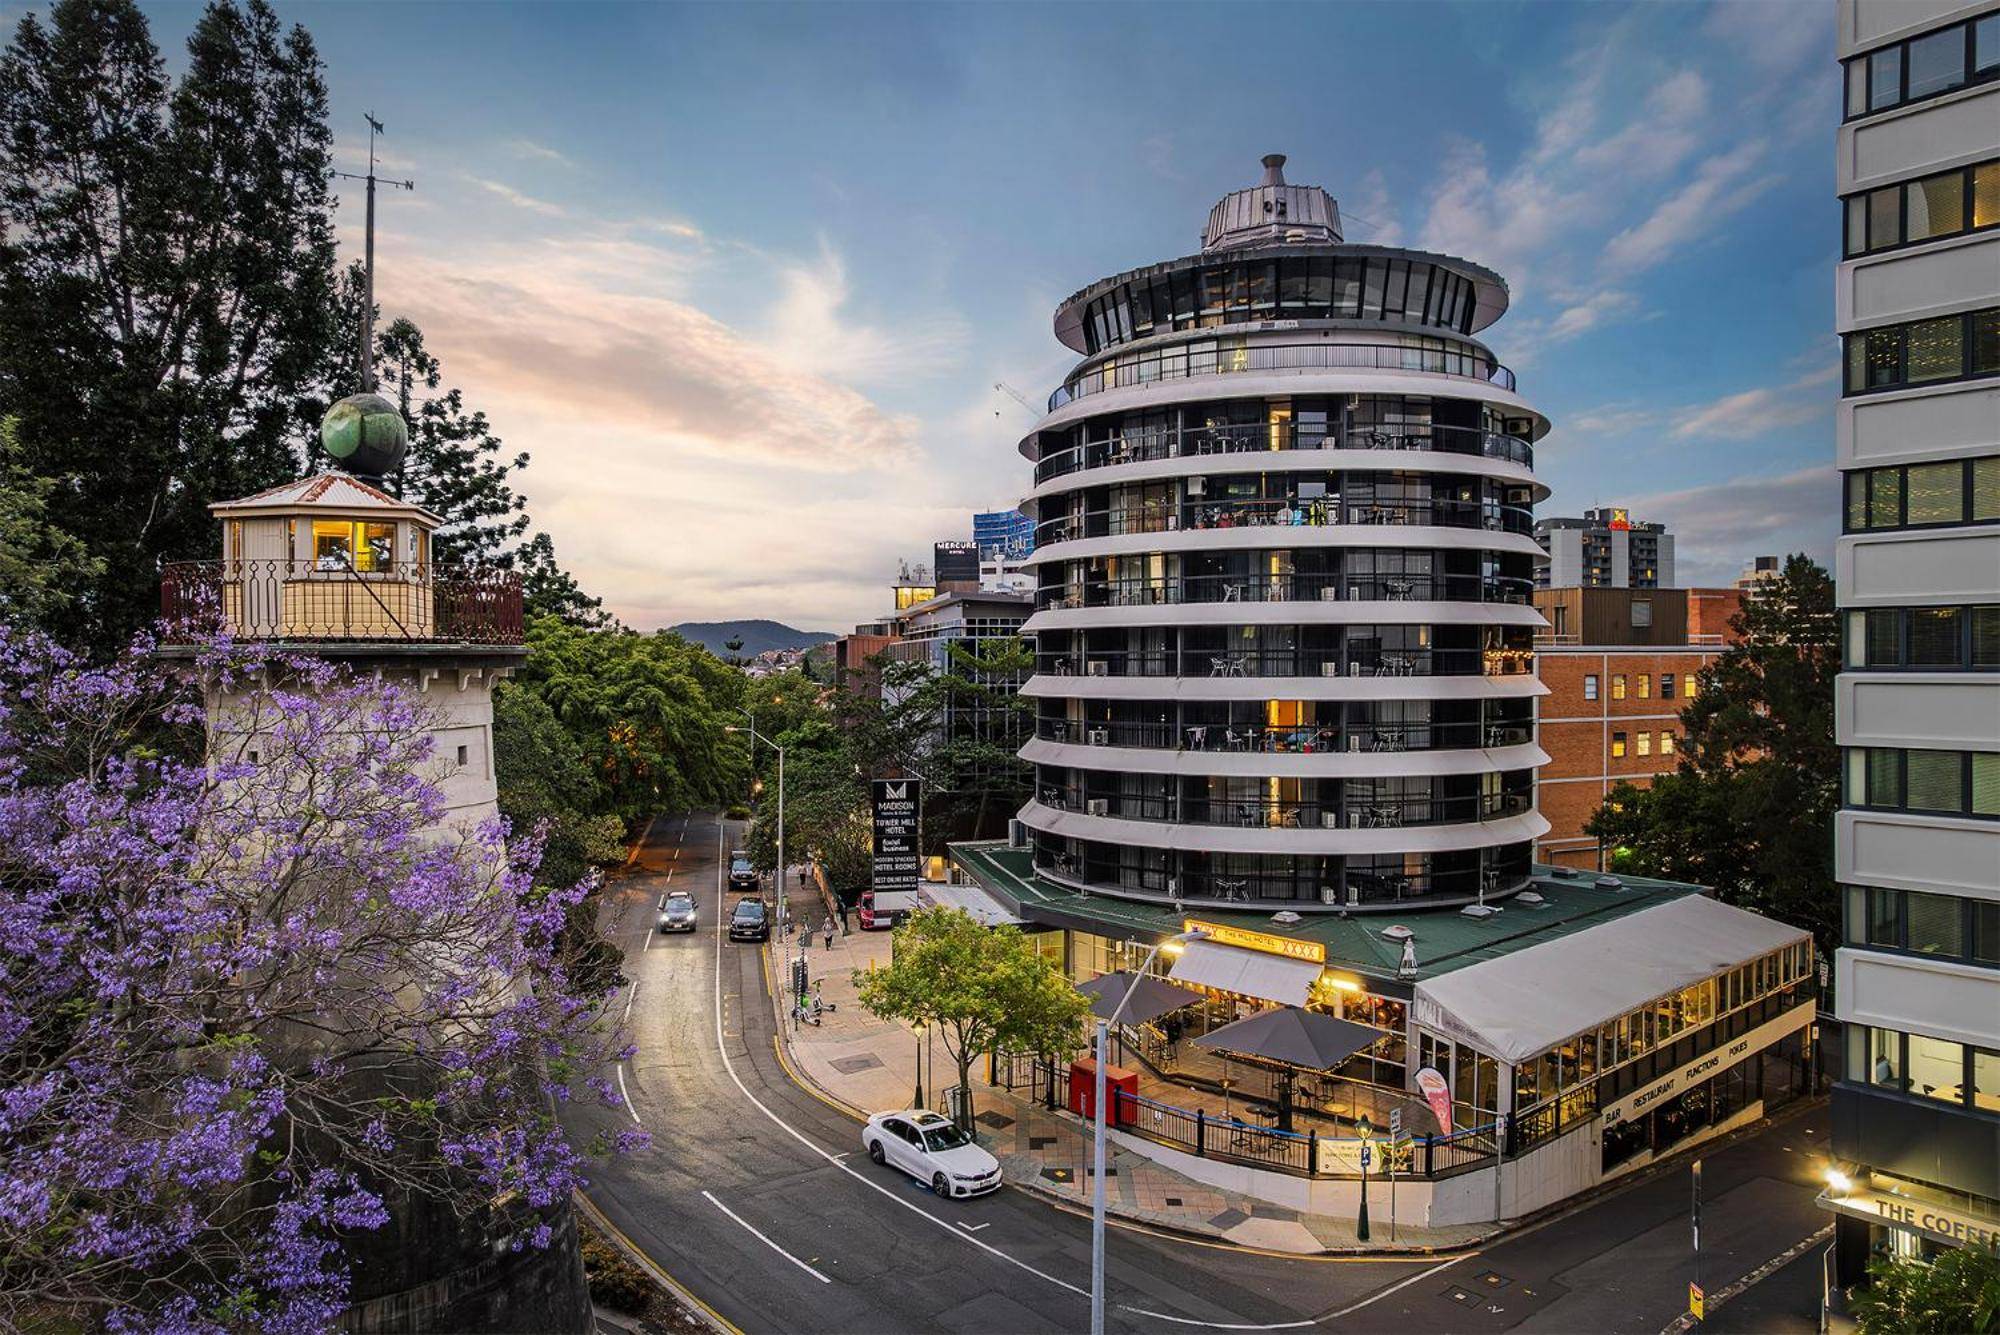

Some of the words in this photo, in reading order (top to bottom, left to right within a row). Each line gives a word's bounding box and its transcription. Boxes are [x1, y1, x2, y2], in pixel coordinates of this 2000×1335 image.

[878, 802, 914, 811] MADISON
[876, 819, 899, 827] TOWER
[901, 818, 916, 826] MILL
[1282, 940, 1316, 958] XXXX
[1605, 1107, 1621, 1124] BAR
[1632, 1078, 1675, 1110] RESTAURANT
[1686, 1055, 1720, 1081] FUNCTIONS
[1363, 1148, 1370, 1158] P
[1875, 1199, 1916, 1223] THE
